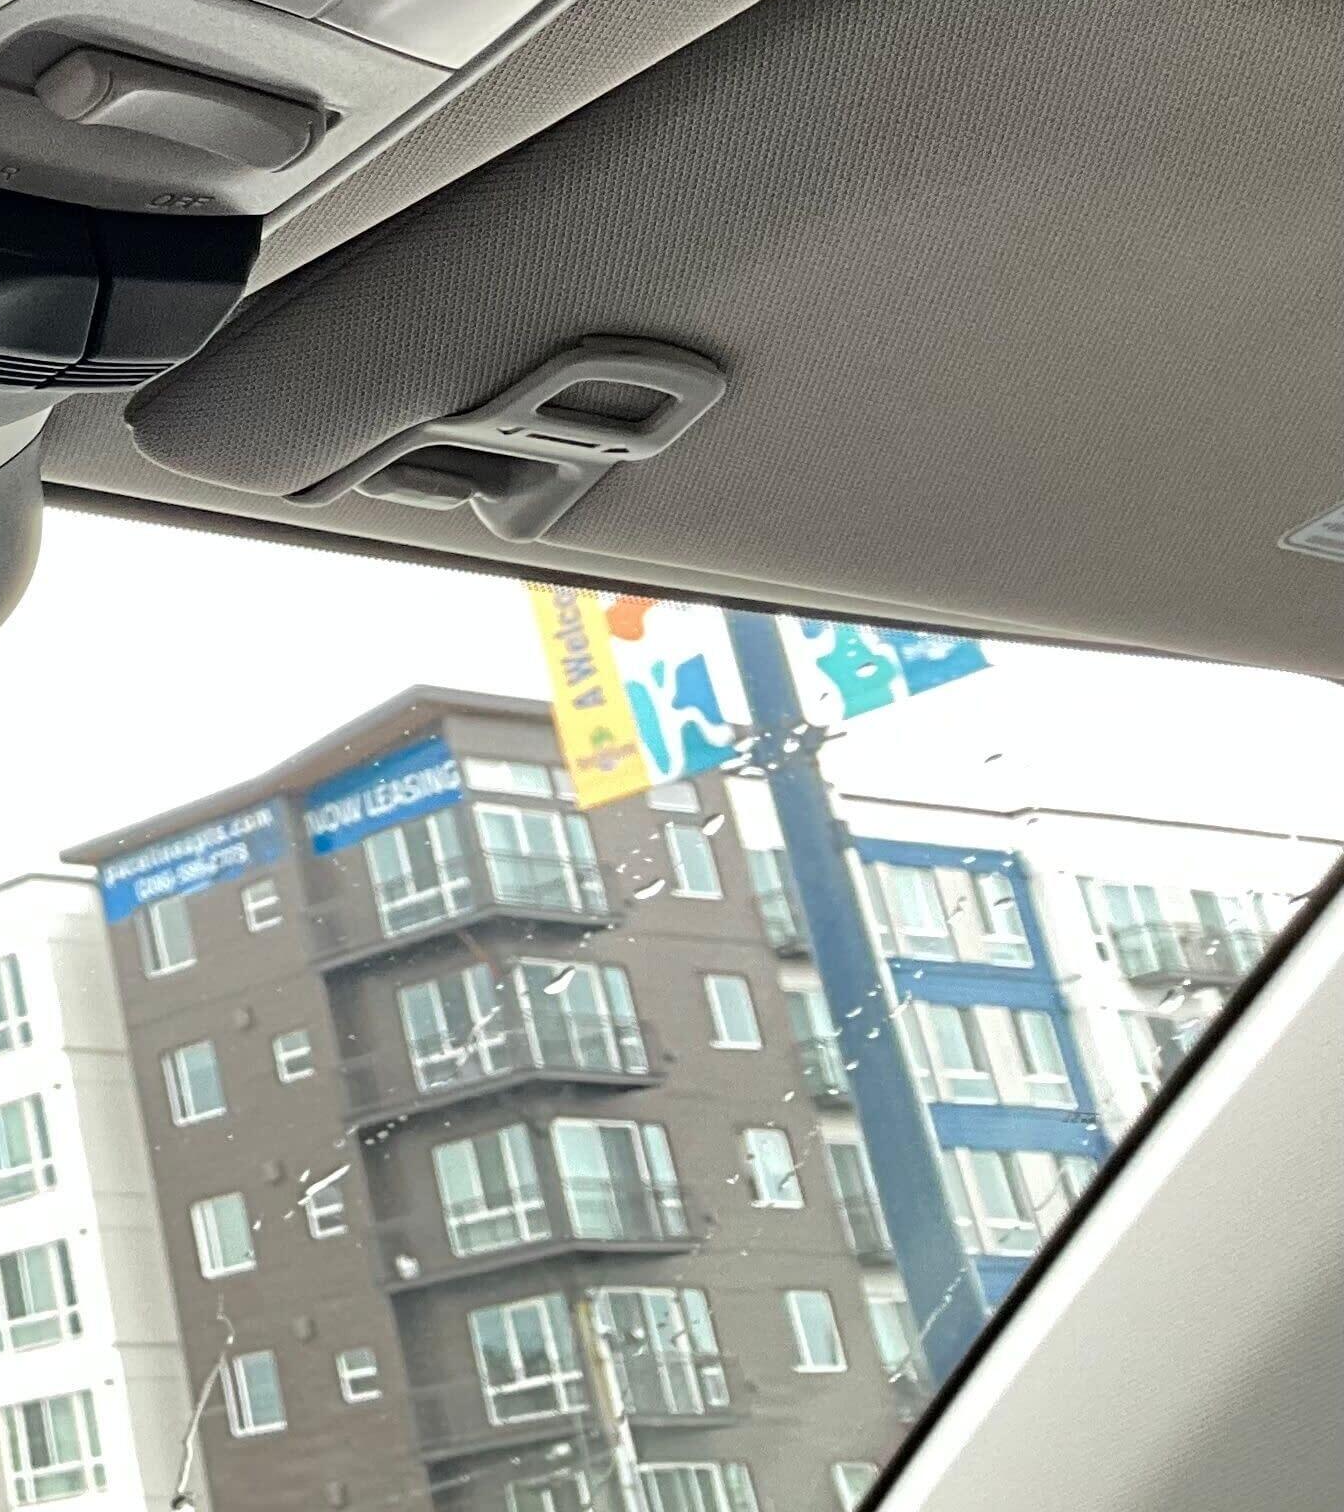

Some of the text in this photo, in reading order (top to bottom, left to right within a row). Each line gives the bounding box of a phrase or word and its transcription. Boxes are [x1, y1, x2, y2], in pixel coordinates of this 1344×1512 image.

[147, 192, 216, 210] OFF
[572, 685, 608, 711] A
[303, 758, 462, 837] NOW LEASING
